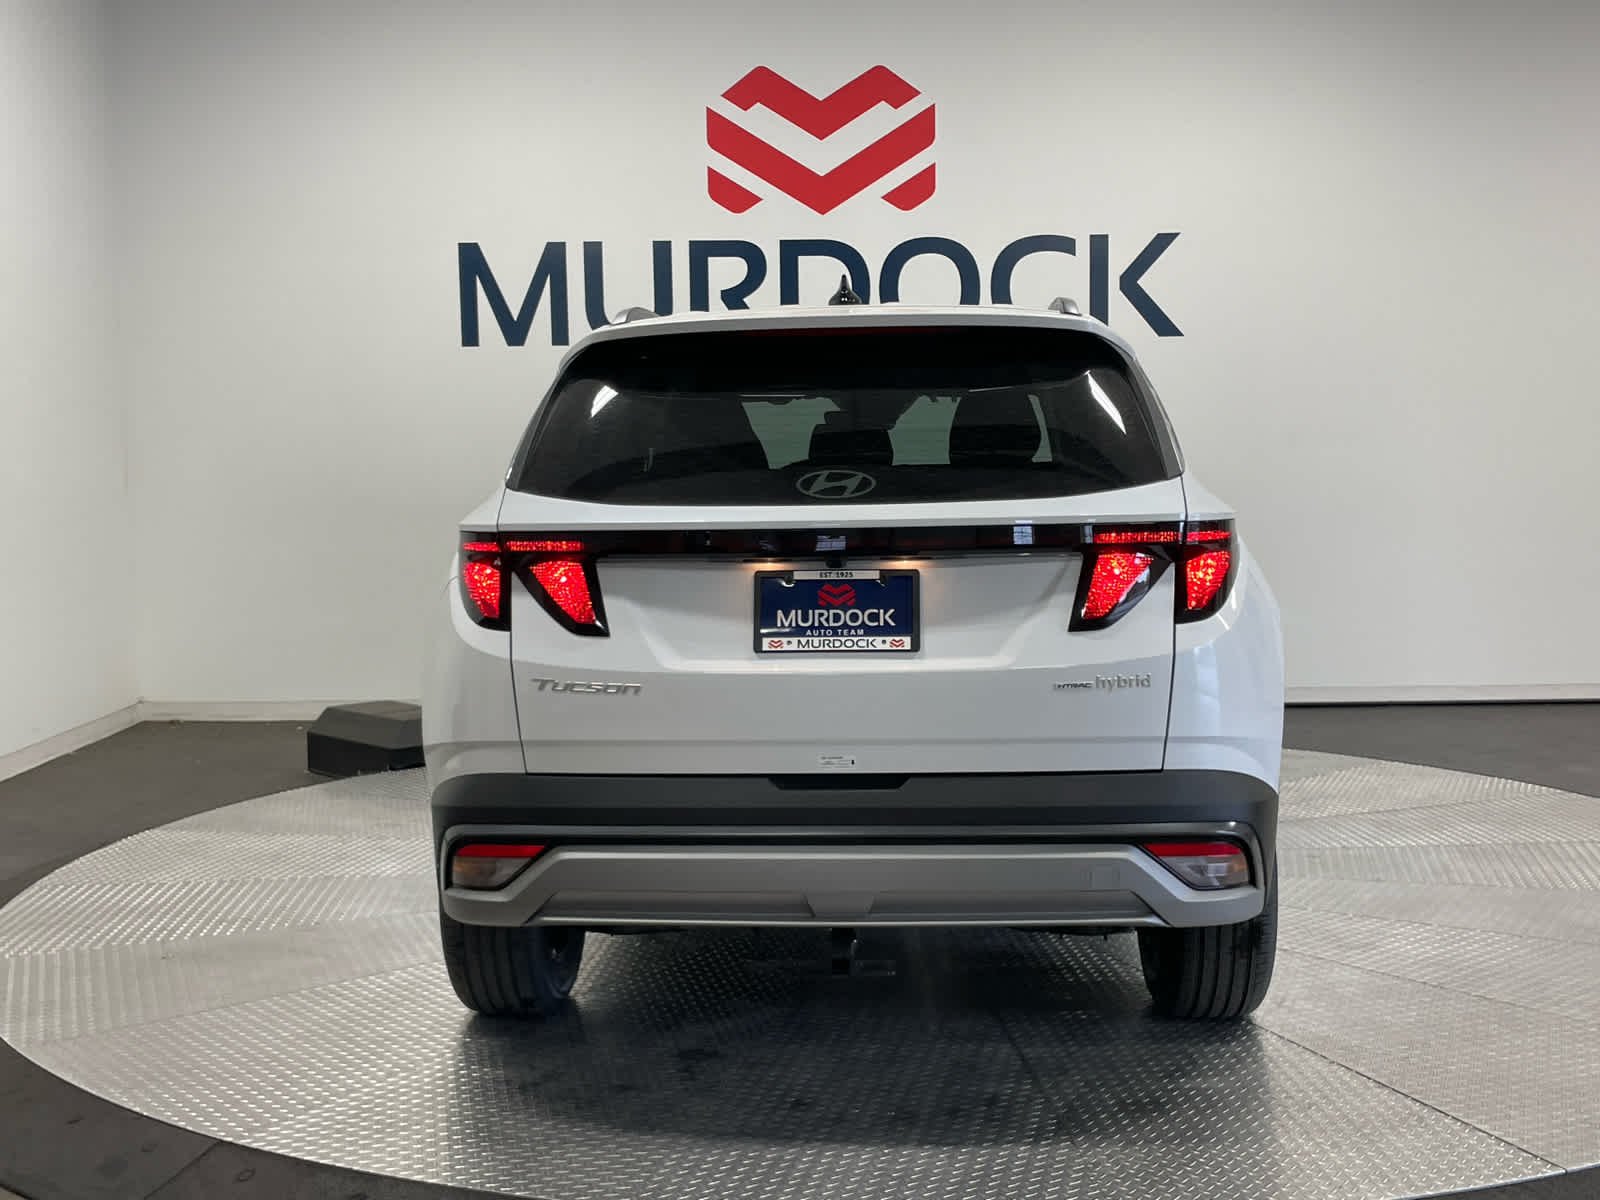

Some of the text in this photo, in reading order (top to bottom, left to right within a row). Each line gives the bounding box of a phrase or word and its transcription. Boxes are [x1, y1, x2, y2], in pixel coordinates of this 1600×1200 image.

[457, 232, 1185, 347] MURDOCK
[777, 608, 896, 627] MURDOCK
[797, 638, 878, 649] MURDOCK
[1095, 672, 1151, 696] hybrid
